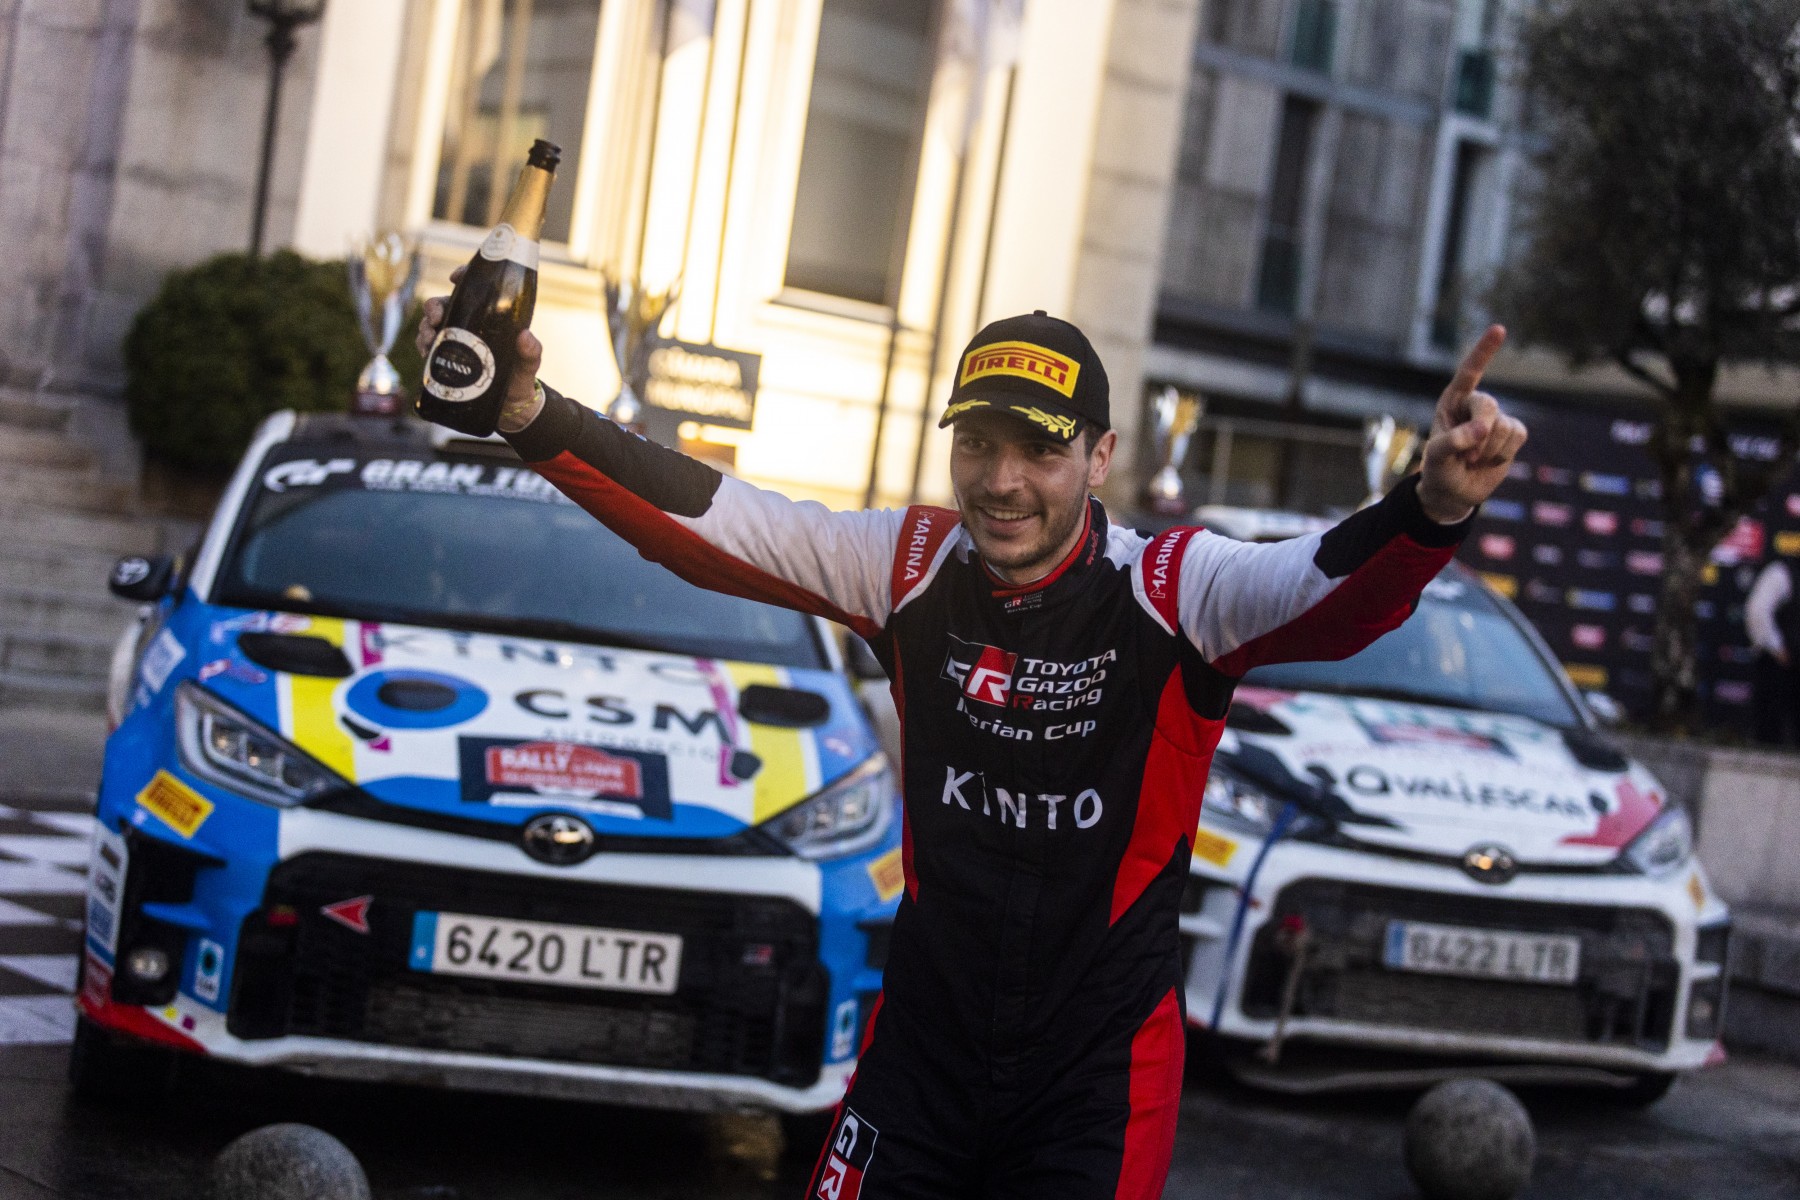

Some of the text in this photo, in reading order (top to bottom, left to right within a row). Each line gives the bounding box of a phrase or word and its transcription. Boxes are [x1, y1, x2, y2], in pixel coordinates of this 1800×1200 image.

[966, 347, 1069, 386] PIRELLI
[361, 459, 485, 486] GRAN
[904, 511, 933, 581] MARINA
[1150, 531, 1184, 599] MARINA
[1017, 669, 1106, 693] GAZOO
[1023, 649, 1116, 677] TOYOTA
[514, 688, 734, 745] CSM
[1013, 688, 1102, 711] Racing
[1044, 720, 1096, 740] Cup
[501, 747, 573, 771] RALLY
[942, 766, 1103, 830] KINTO
[447, 925, 668, 984] 6420 LTR
[820, 1114, 859, 1200] GR
